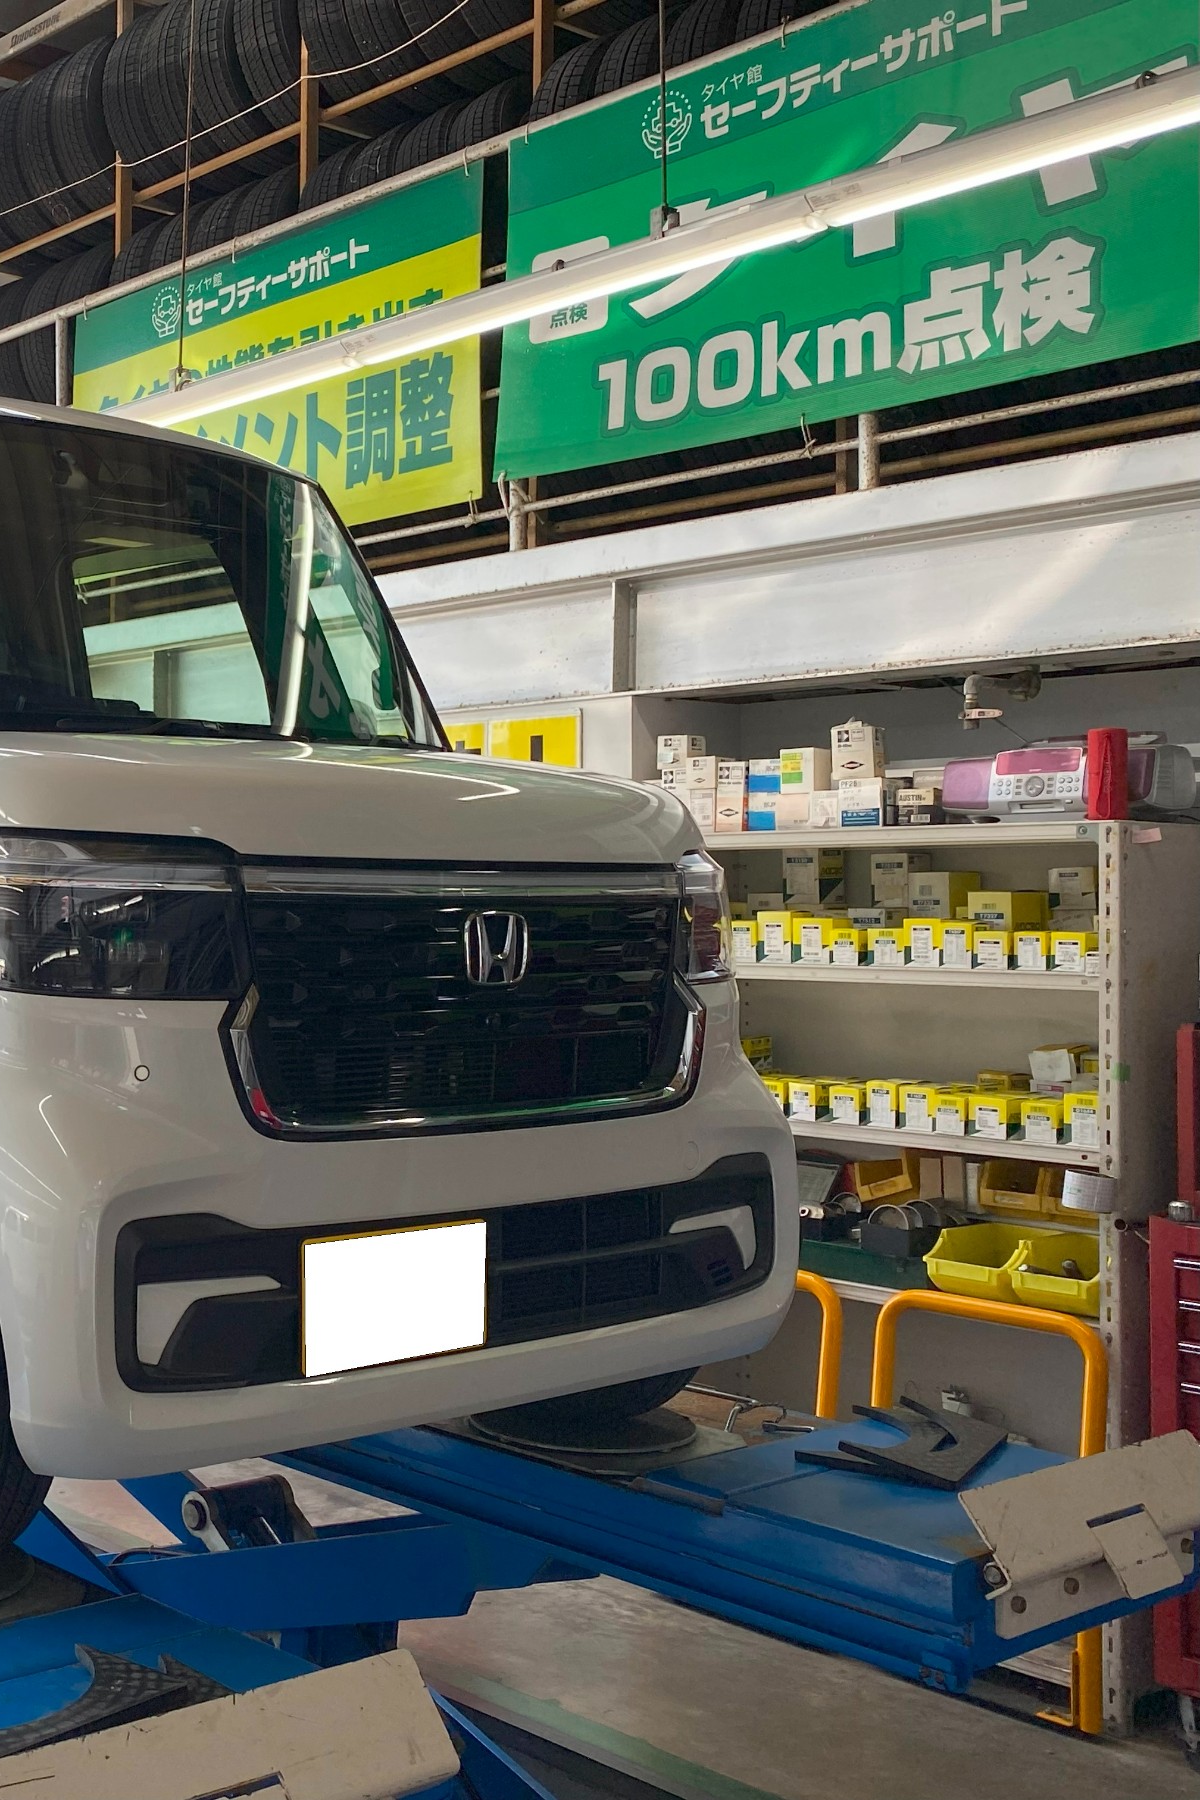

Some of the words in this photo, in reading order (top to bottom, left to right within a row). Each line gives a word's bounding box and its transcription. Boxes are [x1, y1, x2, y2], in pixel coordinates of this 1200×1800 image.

[700, 0, 1028, 139] セーフティーサポート
[702, 63, 763, 102] タイヤ館
[186, 238, 370, 326] セーフティーサポート
[186, 271, 223, 297] タイヤ館
[550, 302, 588, 329] 点検
[598, 236, 1096, 430] 100km点検
